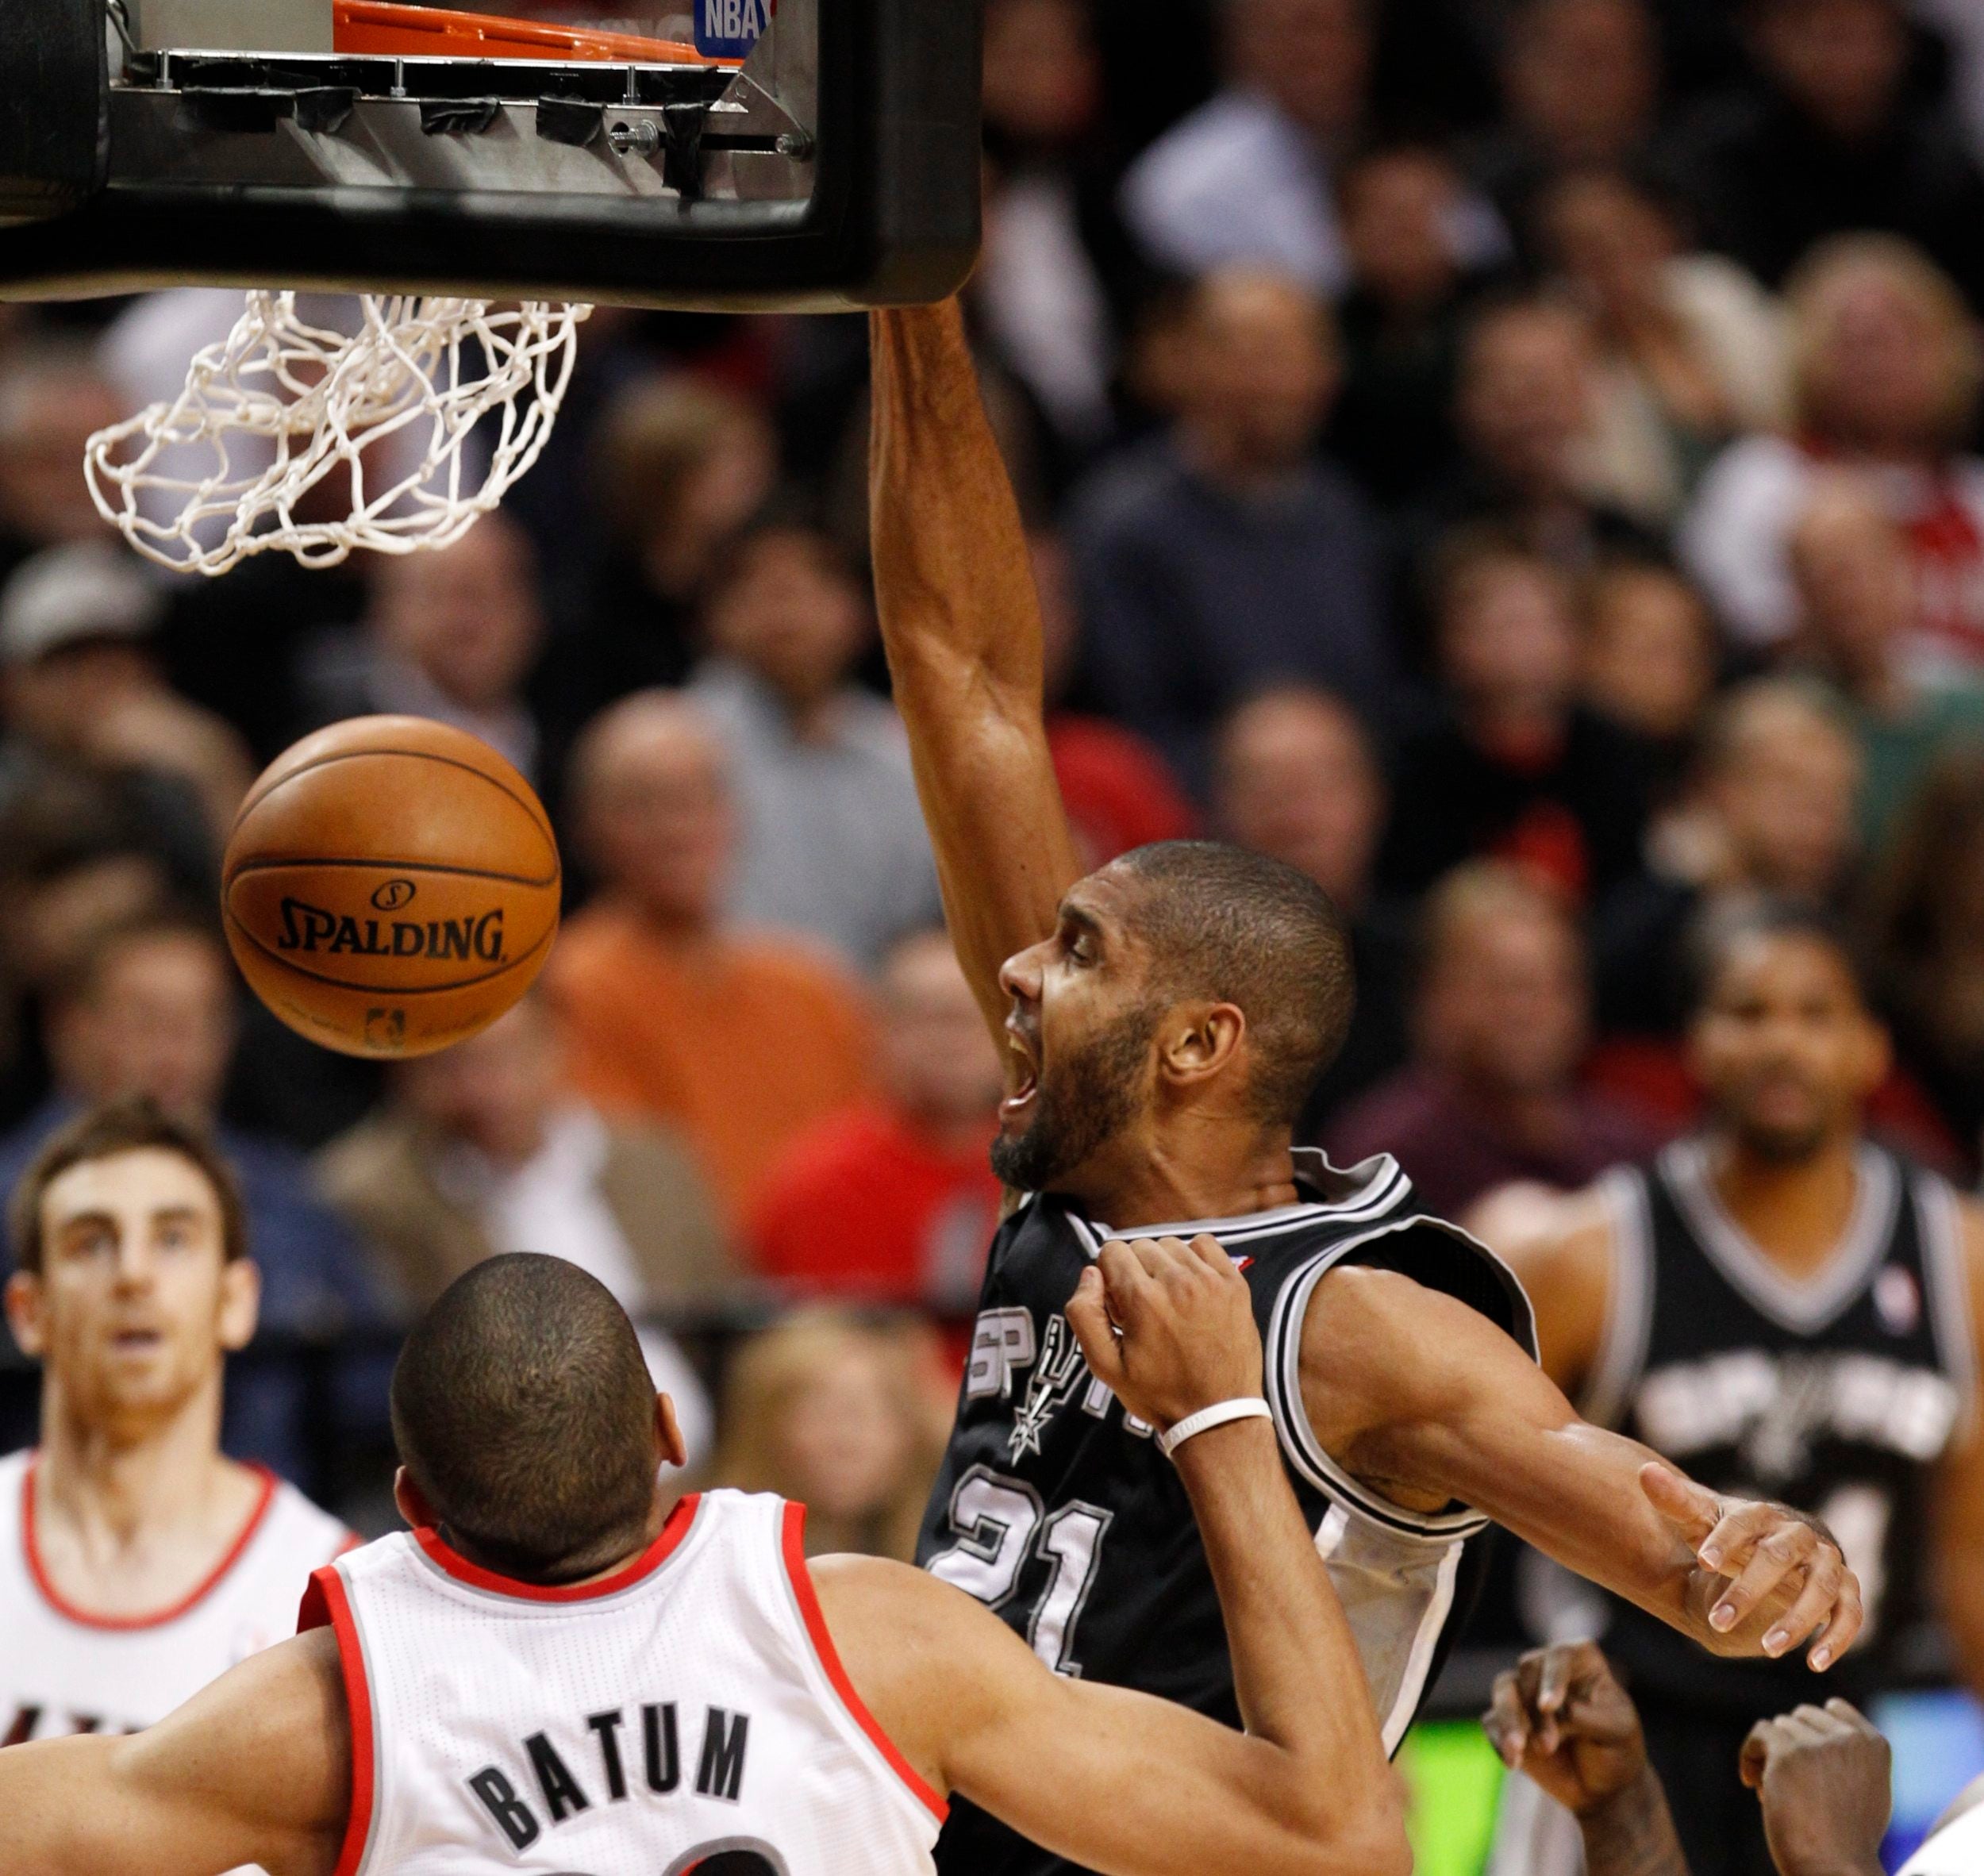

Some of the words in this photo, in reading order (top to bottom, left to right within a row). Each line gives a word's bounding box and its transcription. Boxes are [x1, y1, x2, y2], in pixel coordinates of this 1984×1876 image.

[705, 0, 760, 39] NBA
[279, 897, 504, 962] SPALDING
[925, 1463, 1114, 1678] 21
[463, 1701, 751, 1855] BATUM
